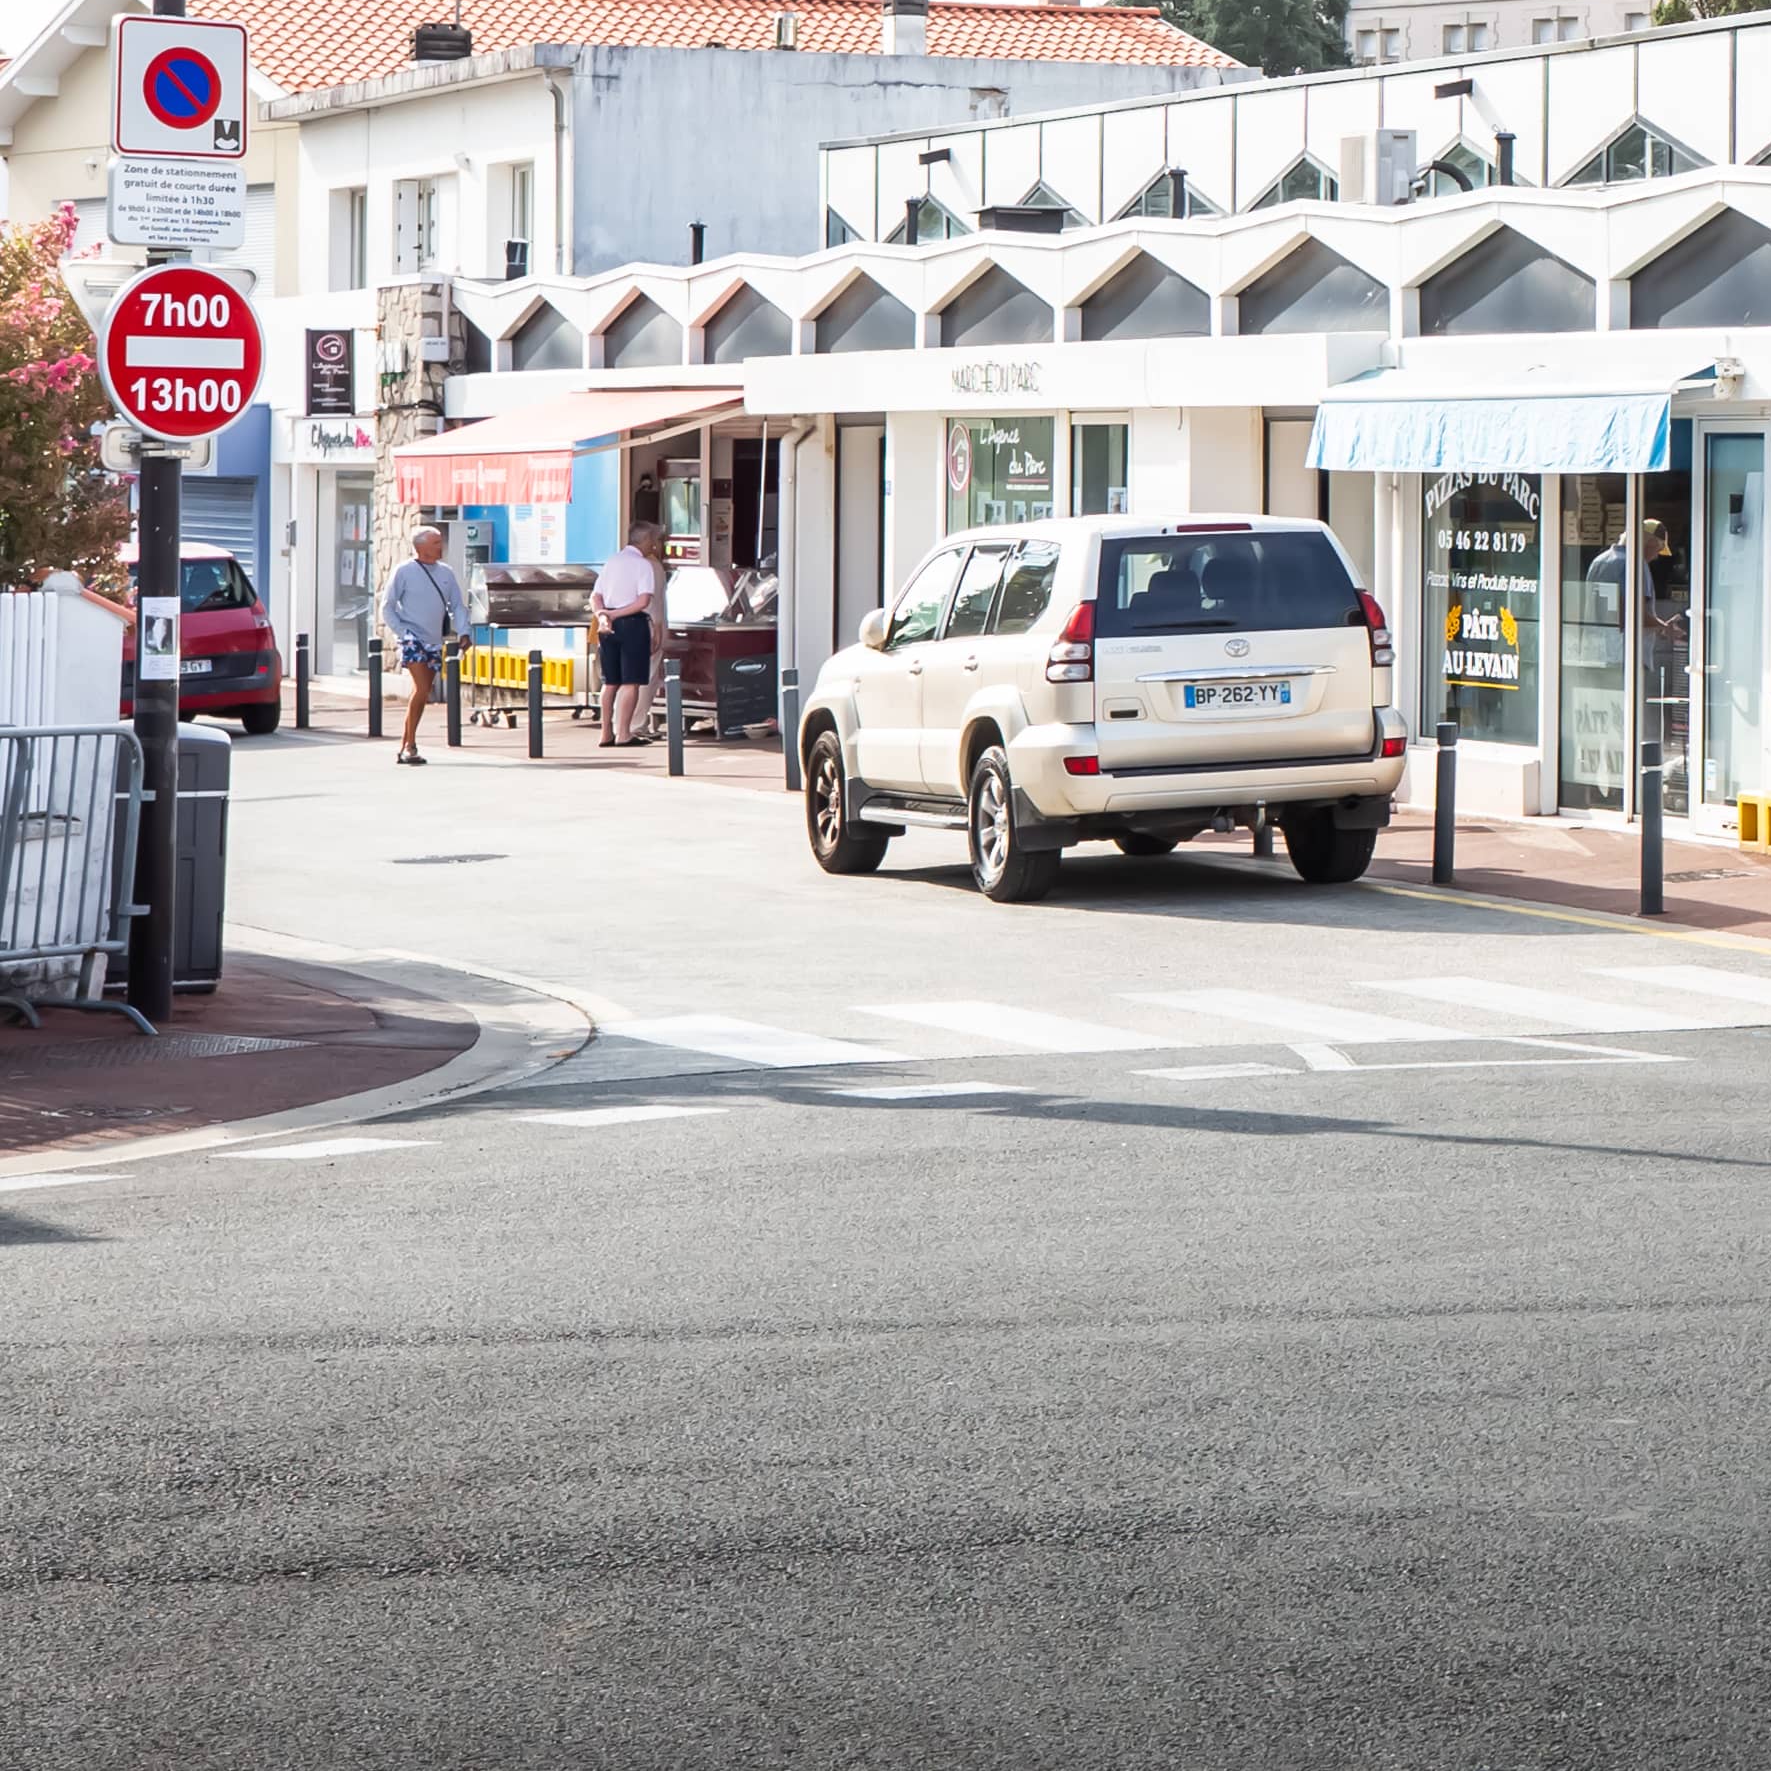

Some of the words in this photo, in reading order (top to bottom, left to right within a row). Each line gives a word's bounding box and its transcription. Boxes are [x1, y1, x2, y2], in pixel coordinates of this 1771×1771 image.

[124, 164, 149, 174] Zone
[151, 166, 164, 175] de
[165, 168, 237, 179] stationnement
[124, 179, 158, 189] gratuit
[160, 180, 172, 189] de
[174, 182, 206, 191] courte
[208, 183, 236, 193] durée
[146, 193, 181, 203] limitée
[182, 195, 188, 204] à
[191, 196, 215, 205] 1h30
[183, 227, 219, 235] dimanche
[140, 293, 230, 328] 7h00
[130, 377, 242, 413] 13h00
[1009, 448, 1023, 475] du
[1024, 451, 1046, 477] Parc
[1425, 473, 1473, 519] PIZZAS
[1502, 473, 1540, 520] PARC
[1438, 529, 1453, 549] 05
[1455, 530, 1471, 550] 46
[1473, 531, 1490, 551] 22
[1492, 531, 1508, 552] 81
[1509, 532, 1527, 553] 79
[1467, 573, 1478, 589] et
[1477, 573, 1509, 592] Produits
[1462, 608, 1500, 640] PÂTE
[1442, 649, 1464, 675] AU
[1465, 651, 1519, 679] LEVAIN
[1195, 685, 1279, 704] BP-262-YY
